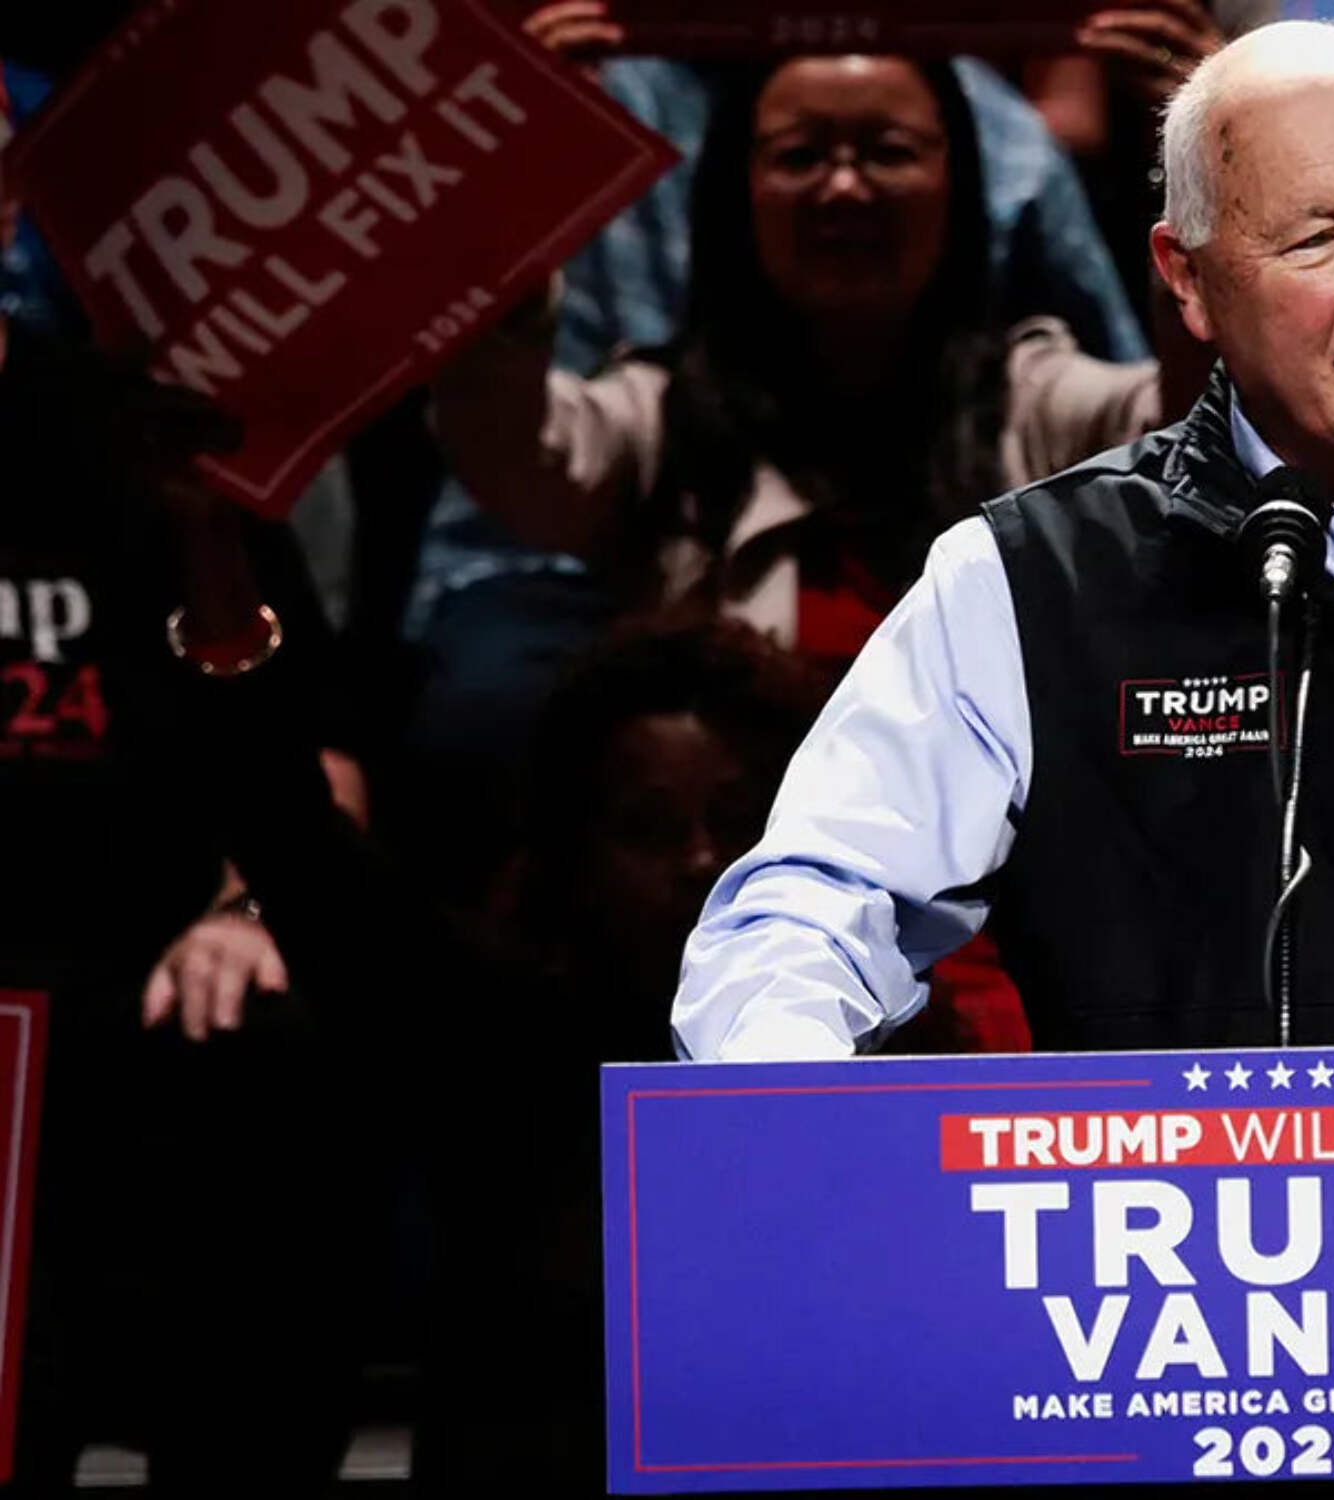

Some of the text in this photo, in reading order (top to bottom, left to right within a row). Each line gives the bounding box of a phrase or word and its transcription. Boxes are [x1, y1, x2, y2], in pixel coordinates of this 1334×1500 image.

[84, 0, 441, 341] TRUMP
[148, 60, 527, 398] WILL FIX IT
[1135, 684, 1271, 716] TRUMP
[1168, 715, 1241, 732] VANCE
[1184, 746, 1224, 759] 2024
[968, 1114, 1202, 1167] TRUMP
[1013, 1393, 1114, 1420] MAKE
[1126, 1388, 1290, 1417] AMERICA
